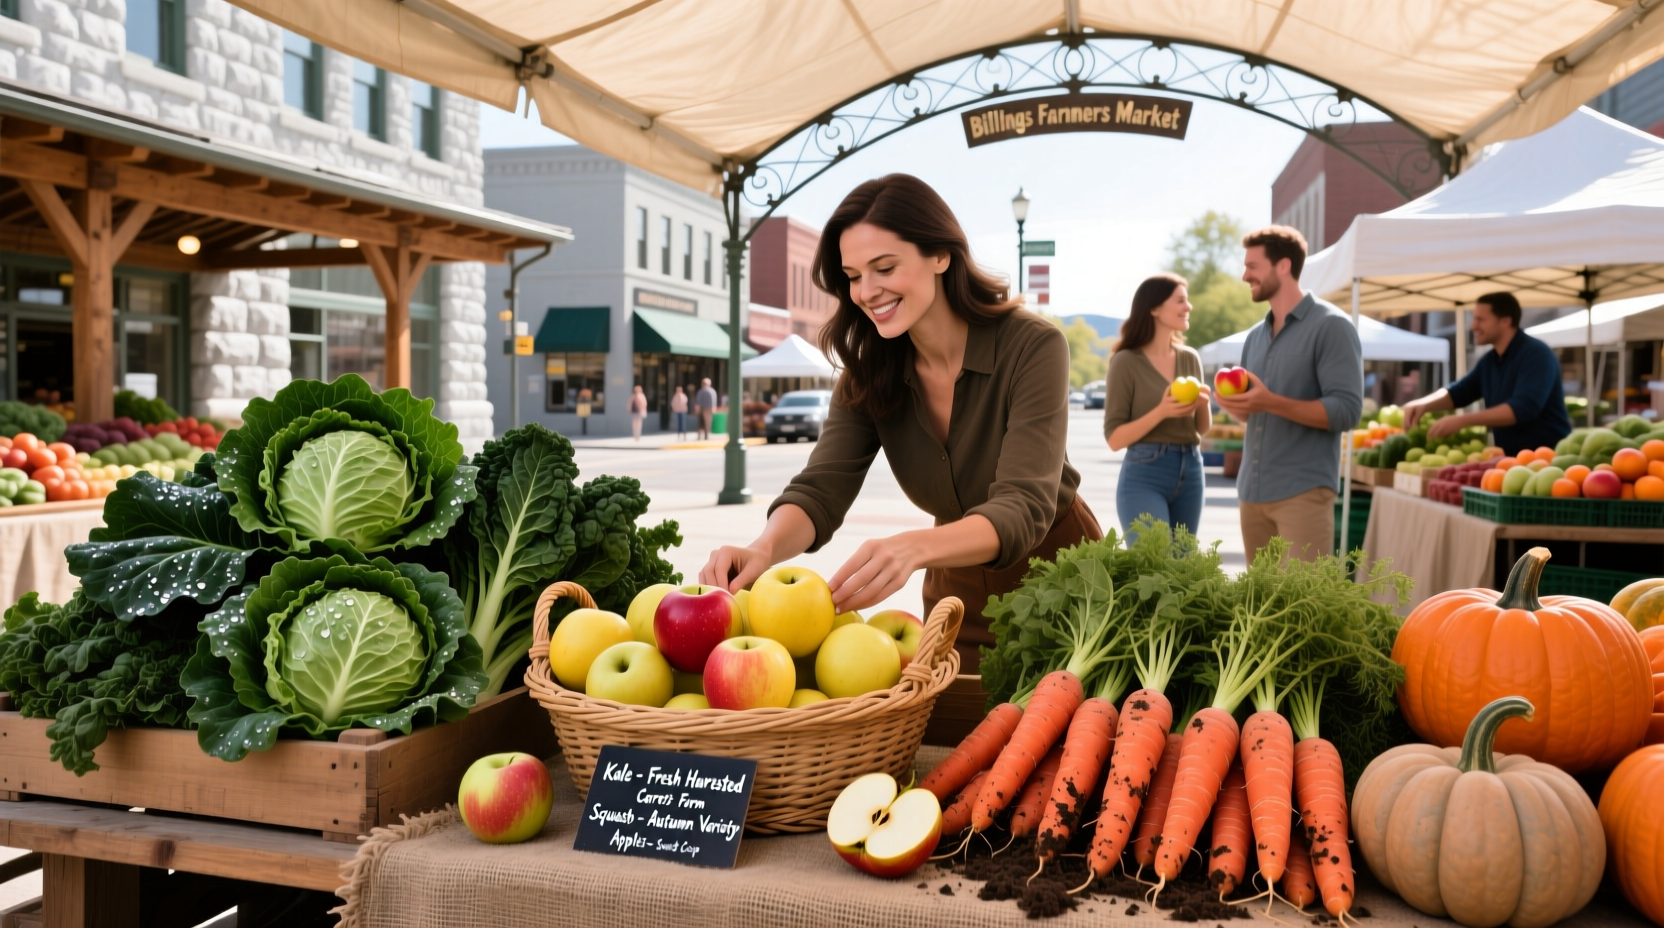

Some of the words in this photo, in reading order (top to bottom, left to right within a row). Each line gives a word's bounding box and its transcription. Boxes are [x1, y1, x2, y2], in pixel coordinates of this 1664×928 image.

[969, 109, 1033, 139] Billings
[1115, 100, 1181, 130] Market
[603, 761, 633, 782] Kale
[647, 766, 681, 787] Fresh
